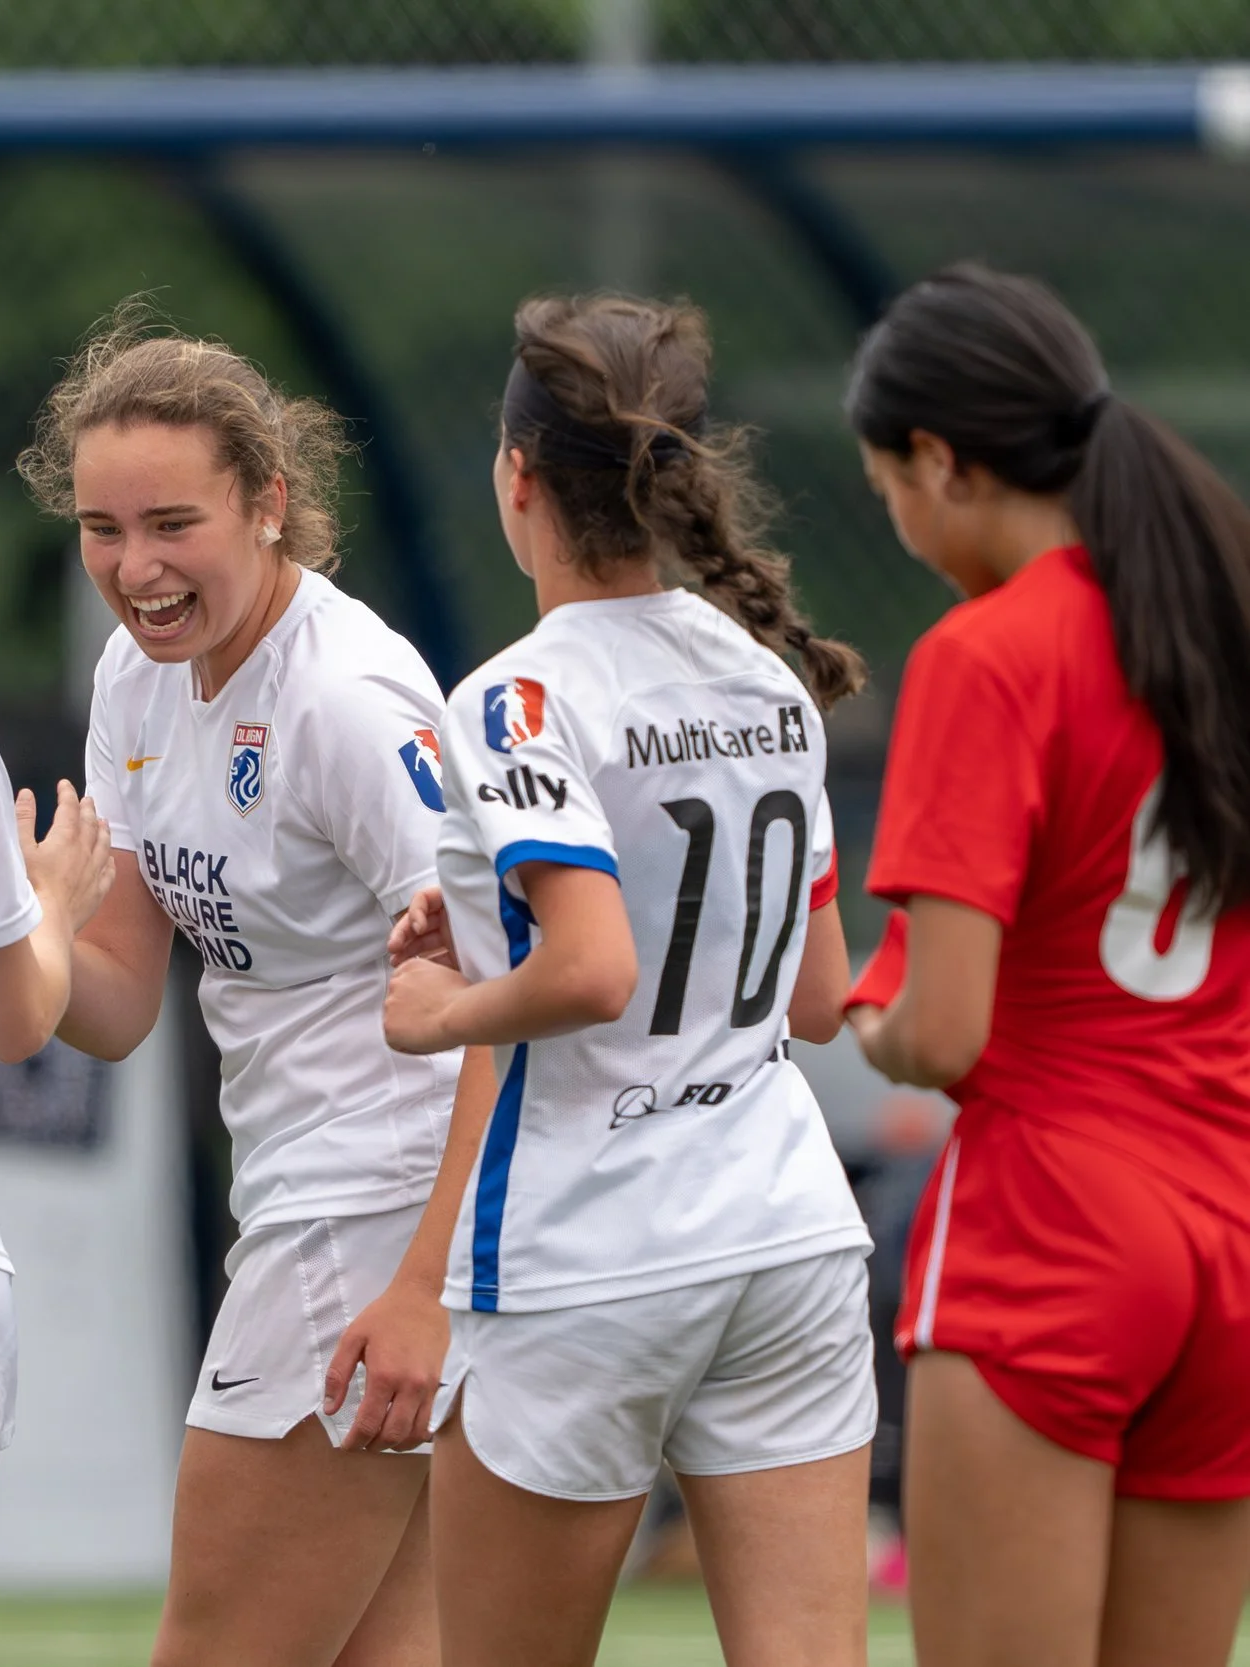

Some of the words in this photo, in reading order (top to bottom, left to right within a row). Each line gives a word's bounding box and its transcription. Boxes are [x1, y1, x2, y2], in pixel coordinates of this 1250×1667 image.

[625, 717, 774, 769] MultiCare
[477, 763, 567, 812] ally
[143, 838, 230, 897] BLACK
[152, 884, 240, 932] FUTURE
[649, 789, 807, 1036] 10
